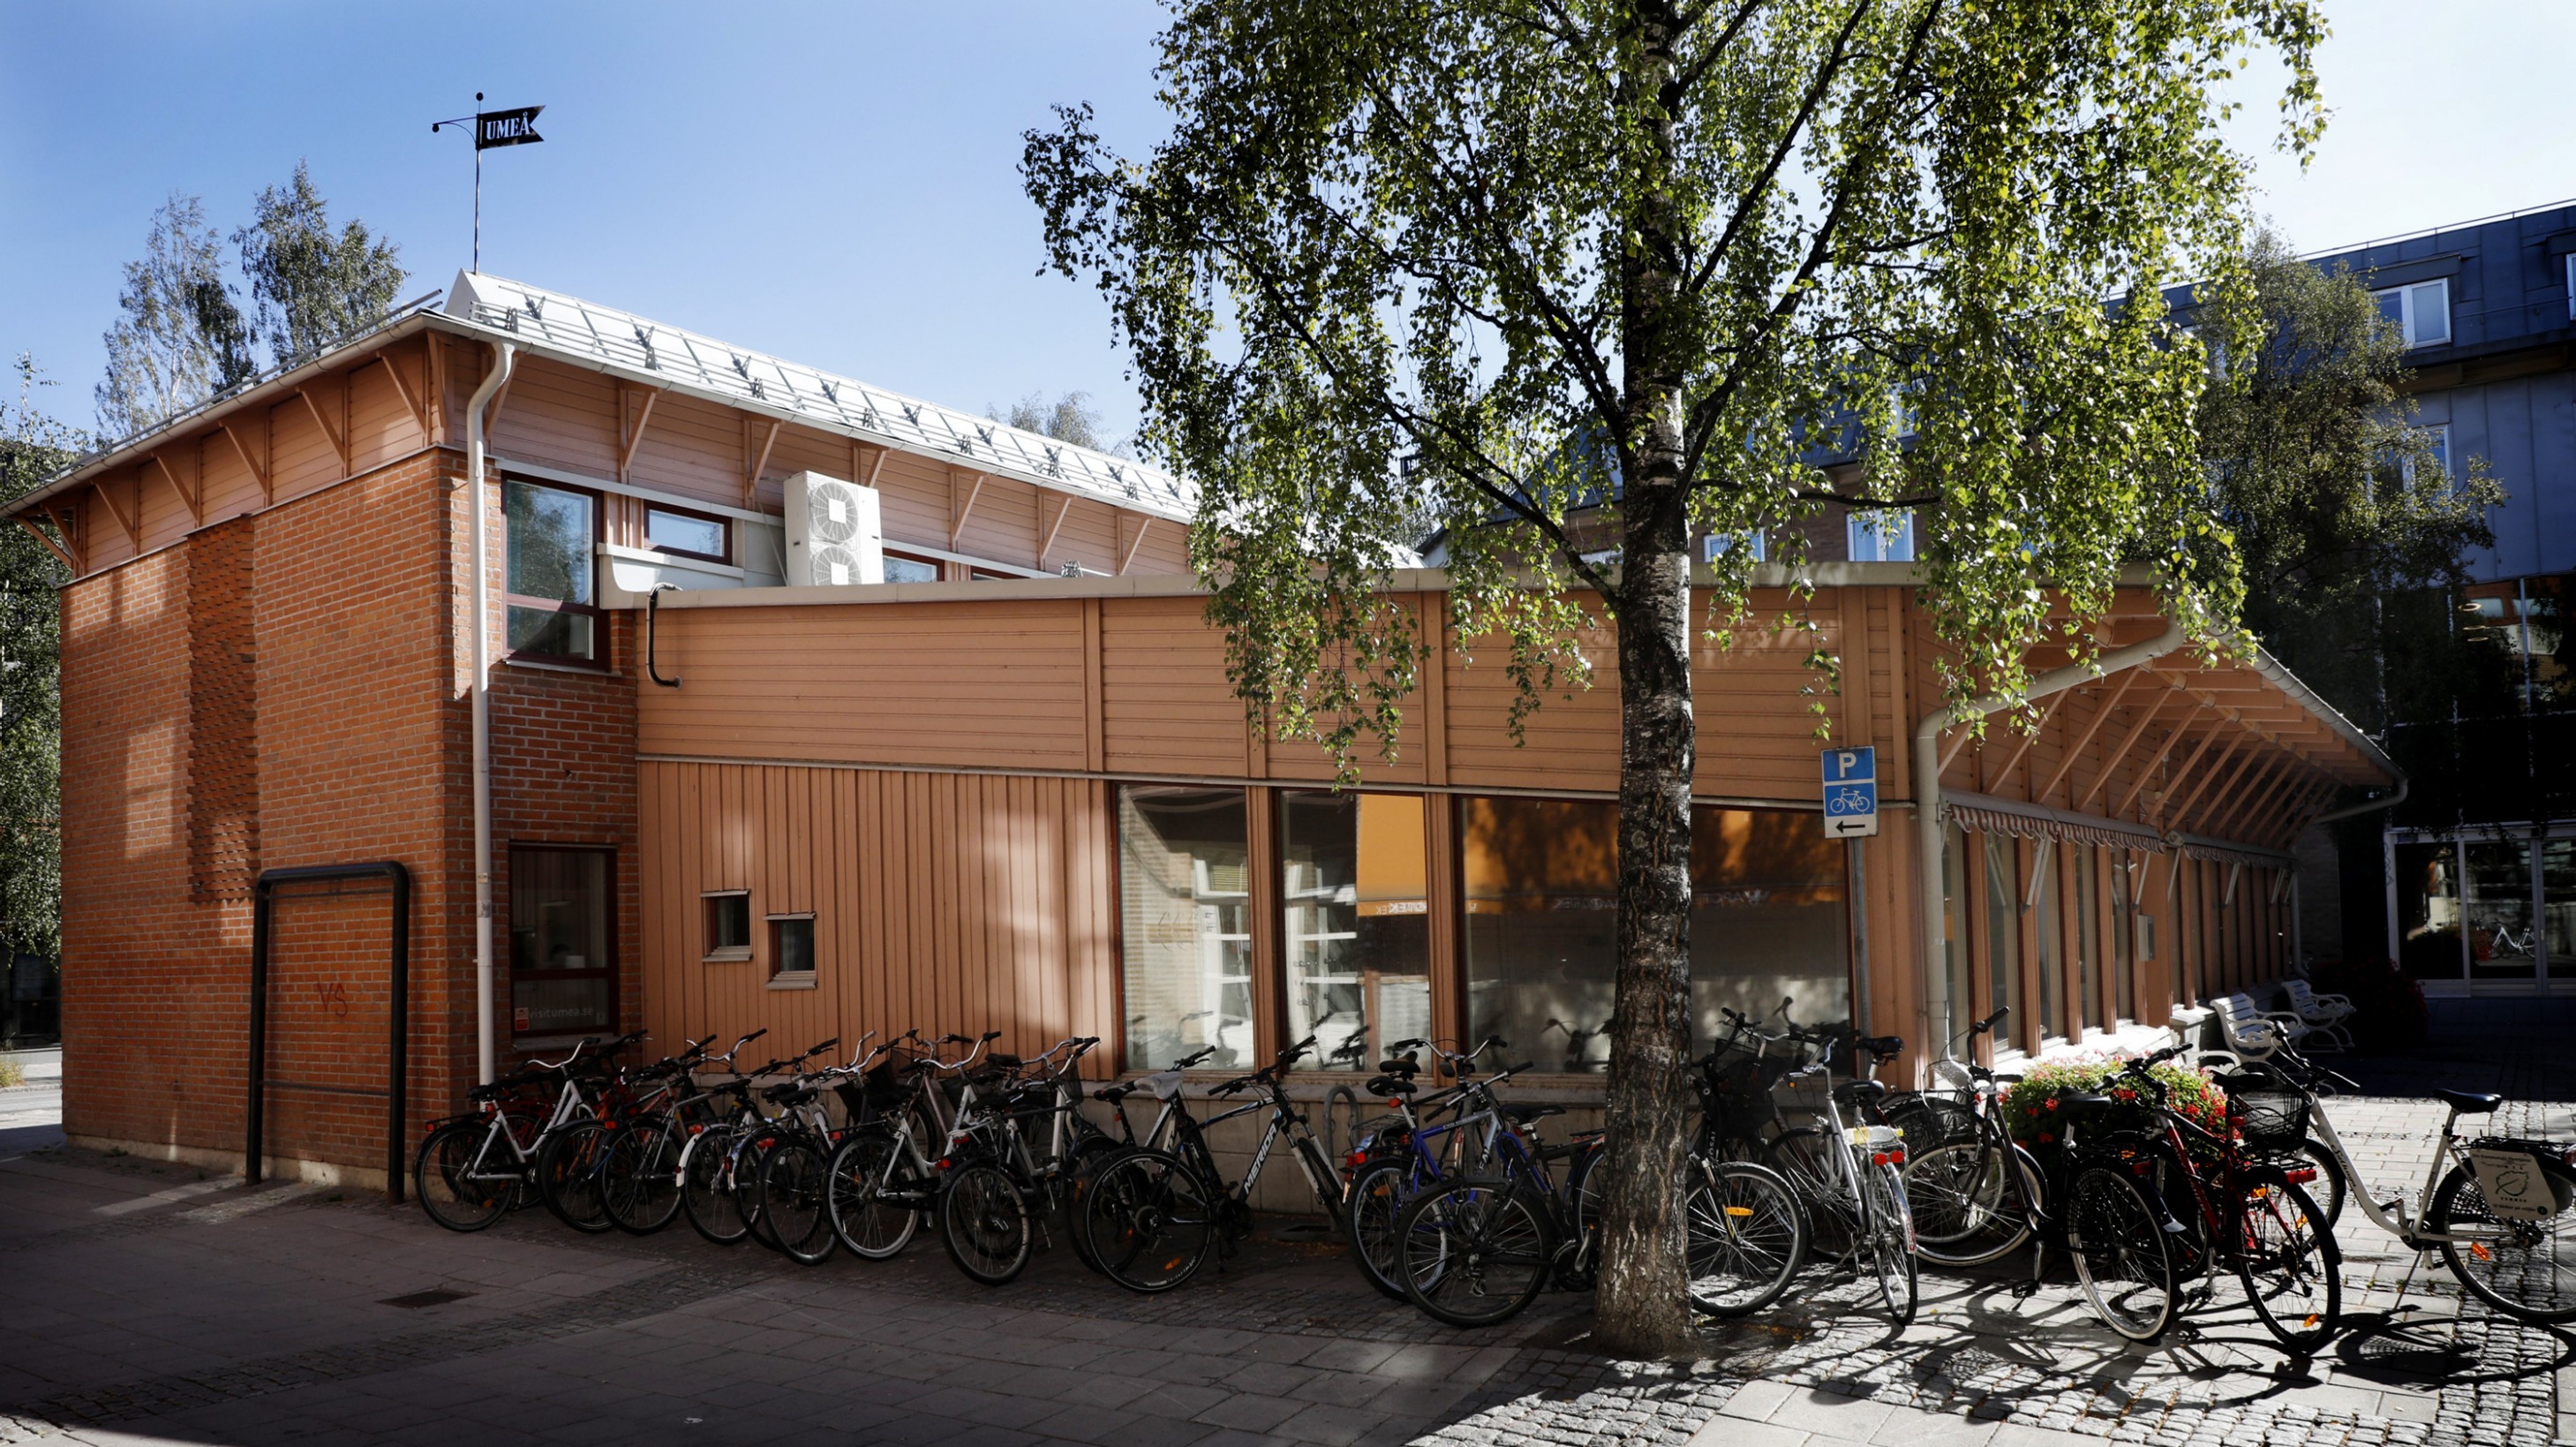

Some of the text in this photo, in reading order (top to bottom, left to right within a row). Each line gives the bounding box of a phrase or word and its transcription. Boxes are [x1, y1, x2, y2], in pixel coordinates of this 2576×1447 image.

[486, 111, 531, 140] UMEÅ
[1839, 752, 1857, 778] P
[1243, 1122, 1277, 1195] MERIDA
